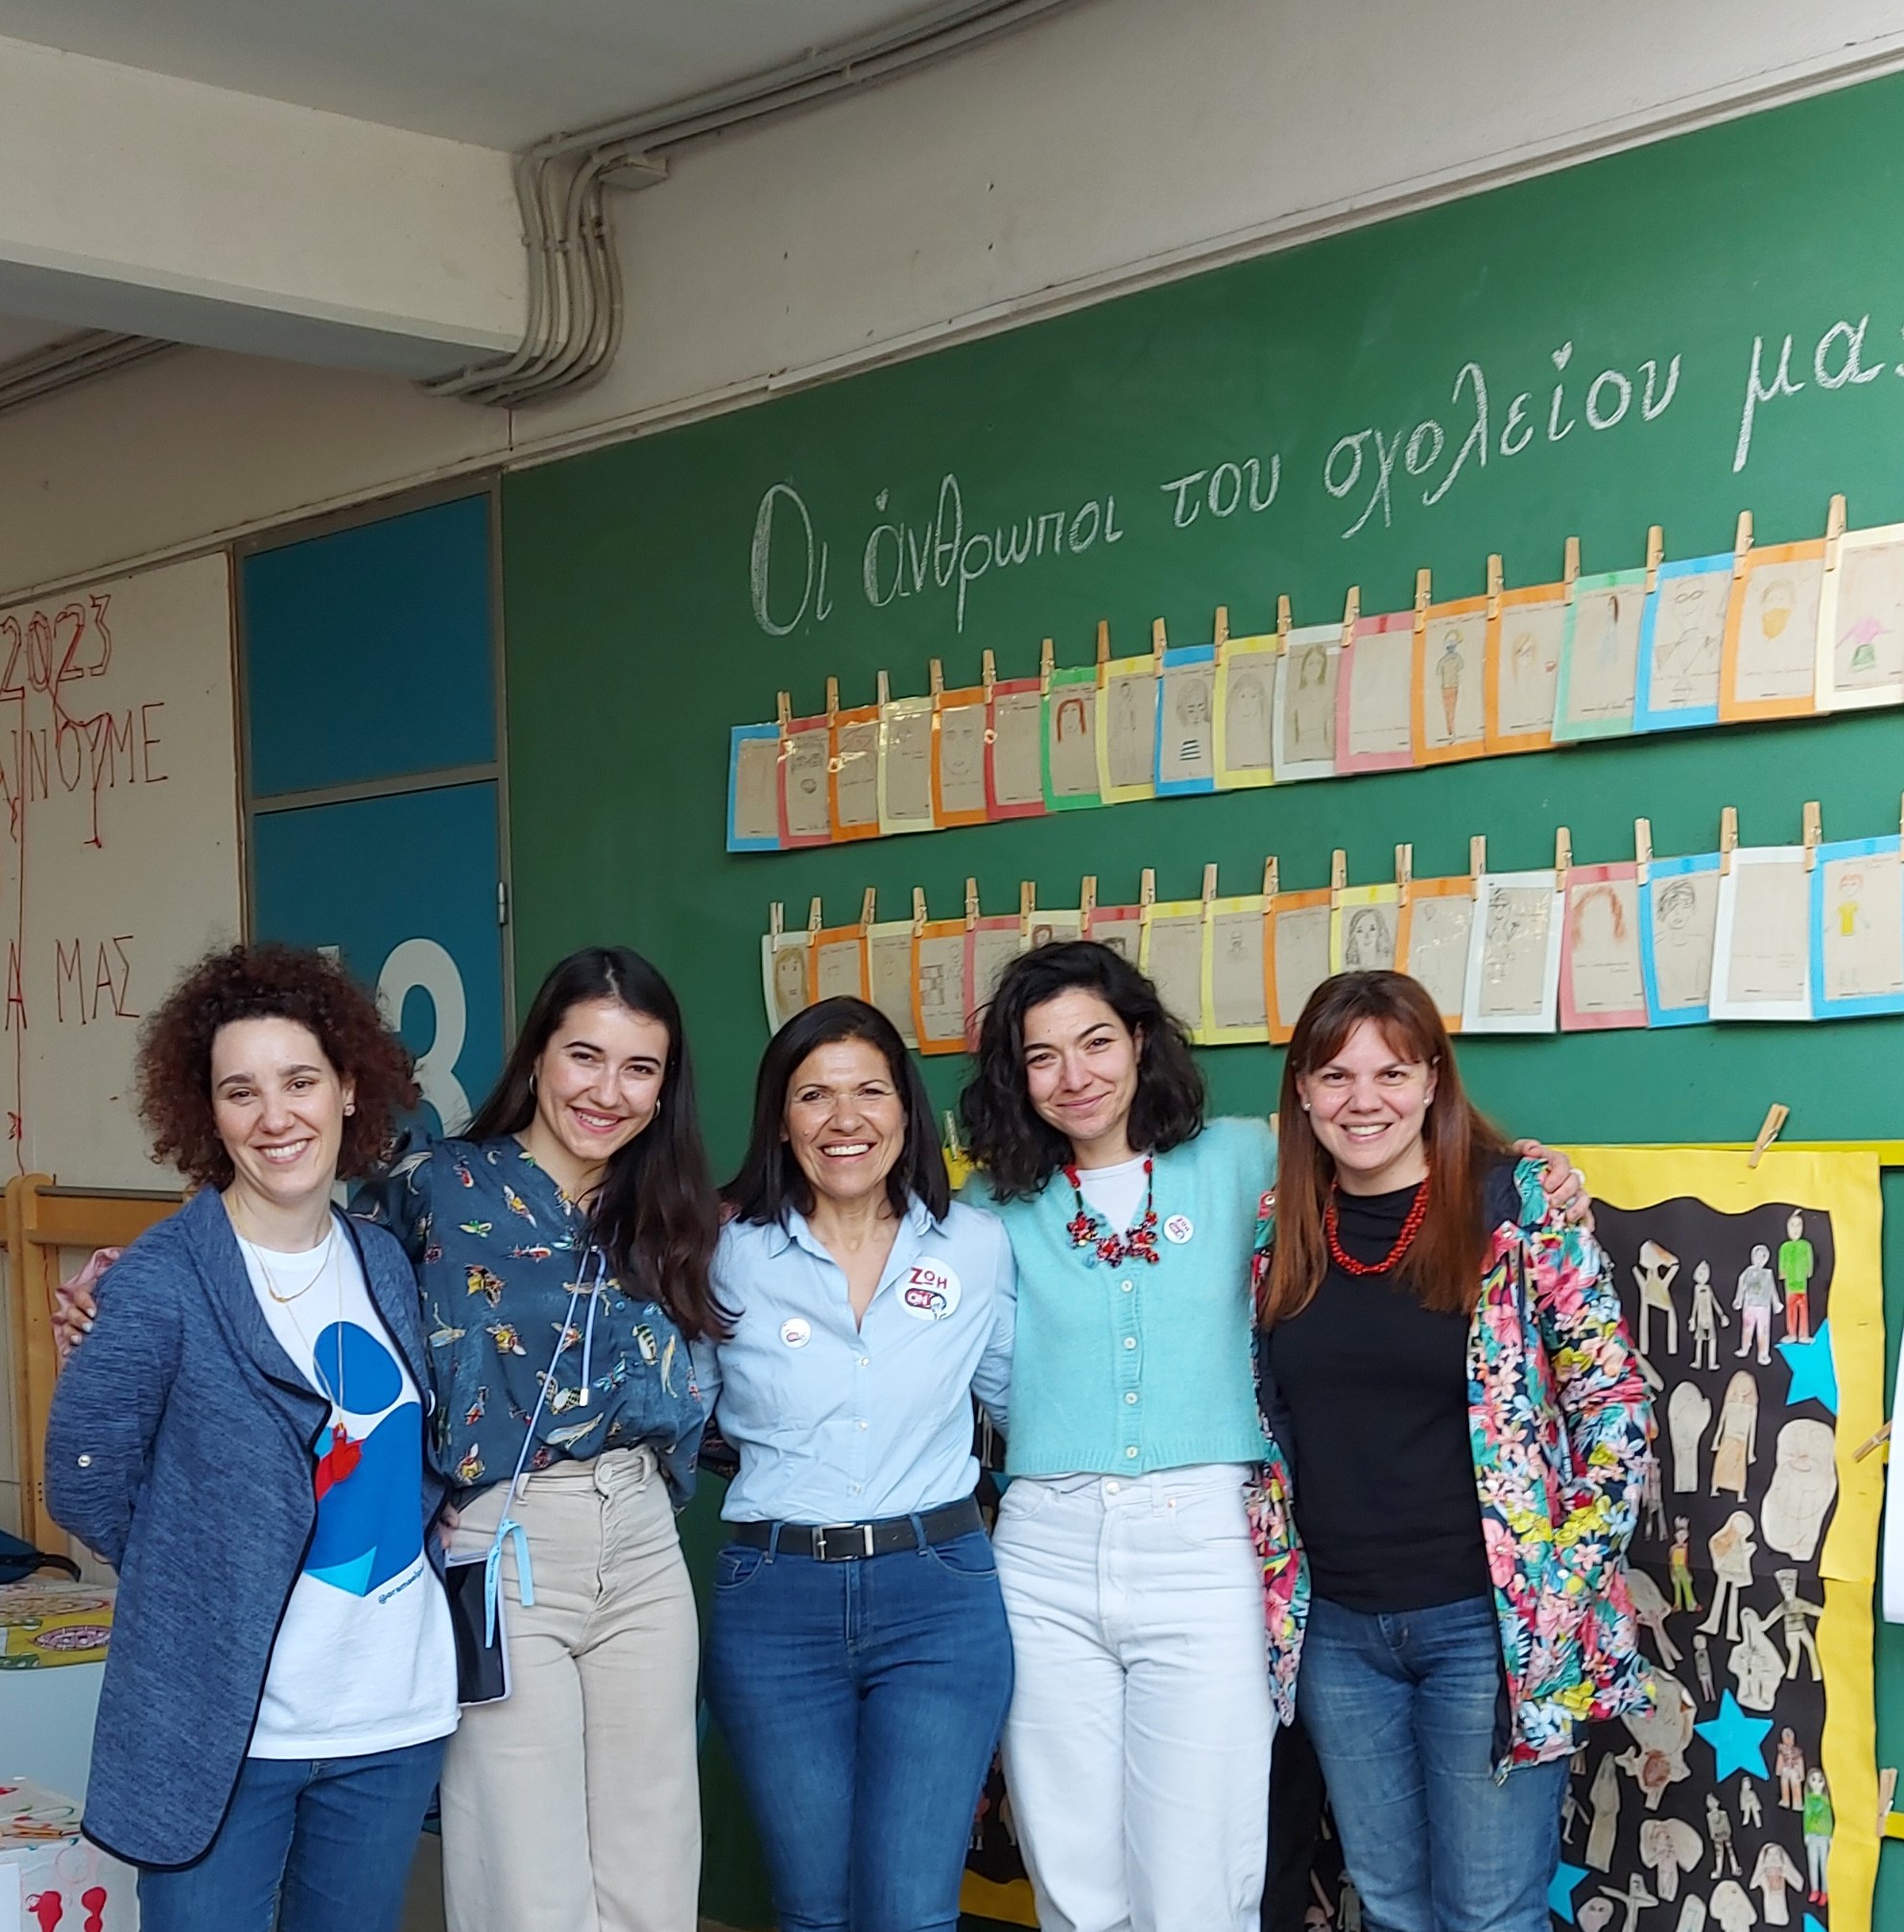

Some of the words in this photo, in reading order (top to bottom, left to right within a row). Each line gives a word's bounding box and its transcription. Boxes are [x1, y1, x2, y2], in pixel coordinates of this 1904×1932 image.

[751, 483, 833, 635] Οι
[865, 474, 1124, 633] άνθρωποι
[1160, 453, 1282, 529] του
[1324, 341, 1682, 539] σχολείου
[0, 593, 112, 702] 2023
[0, 702, 168, 803] ΙΝΟΥΜΕ
[55, 935, 141, 1025] ΜΑΣ
